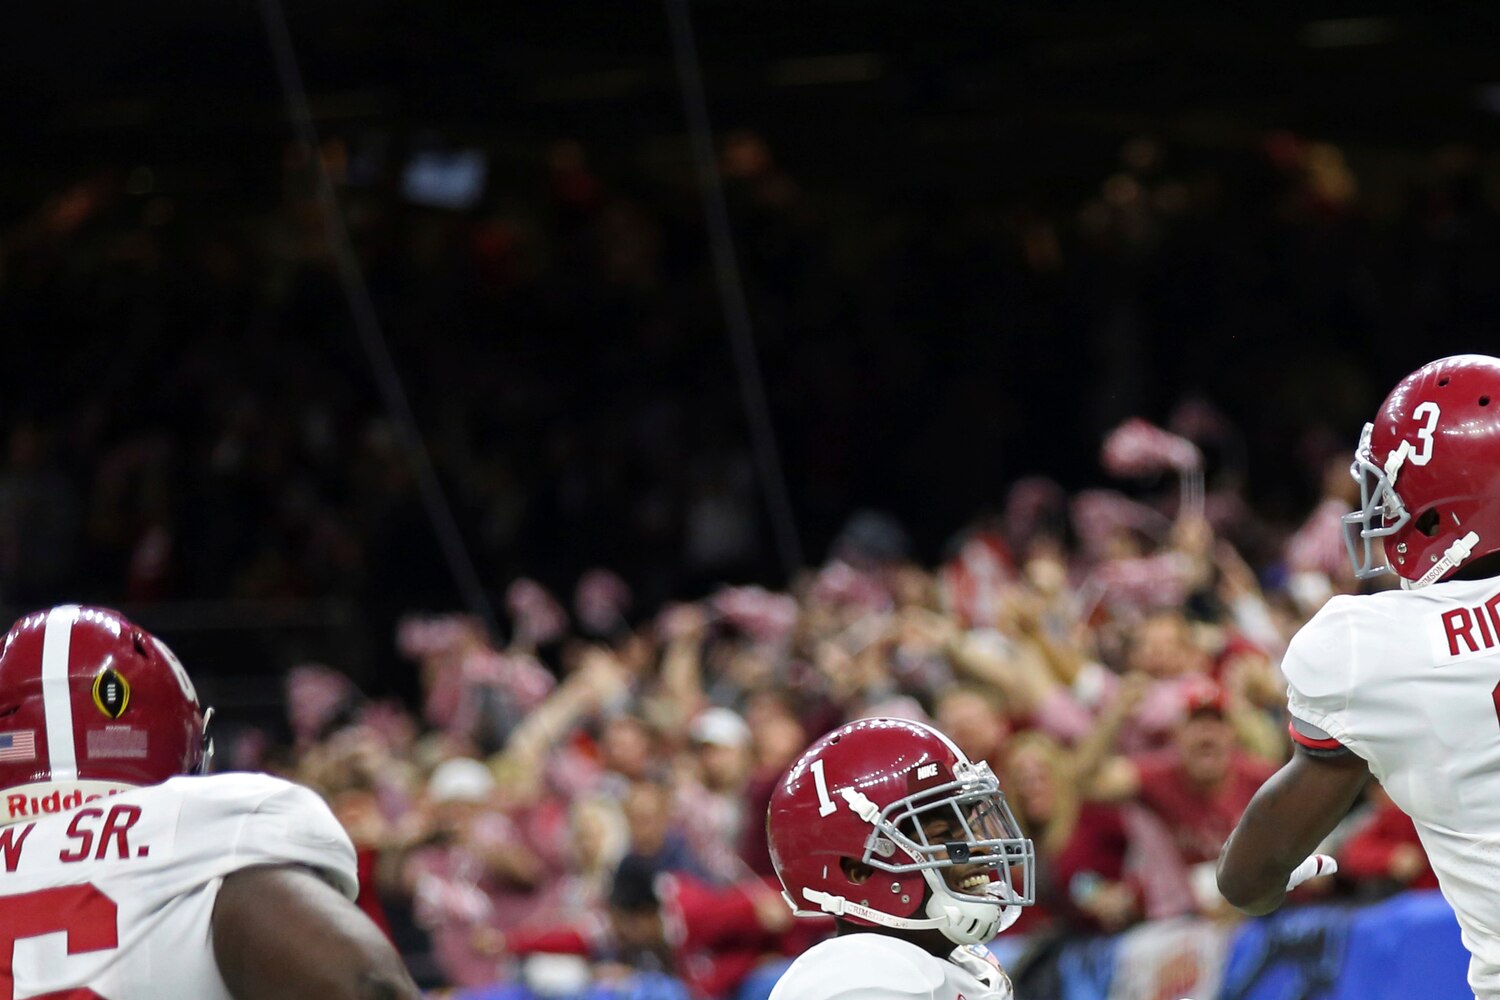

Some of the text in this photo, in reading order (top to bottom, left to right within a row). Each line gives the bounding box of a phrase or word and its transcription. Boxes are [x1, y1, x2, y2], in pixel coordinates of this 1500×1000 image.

[1407, 401, 1441, 467] 3
[810, 759, 837, 817] 1
[917, 762, 939, 781] NIKE
[6, 788, 126, 819] Ridd
[59, 803, 150, 864] SR.
